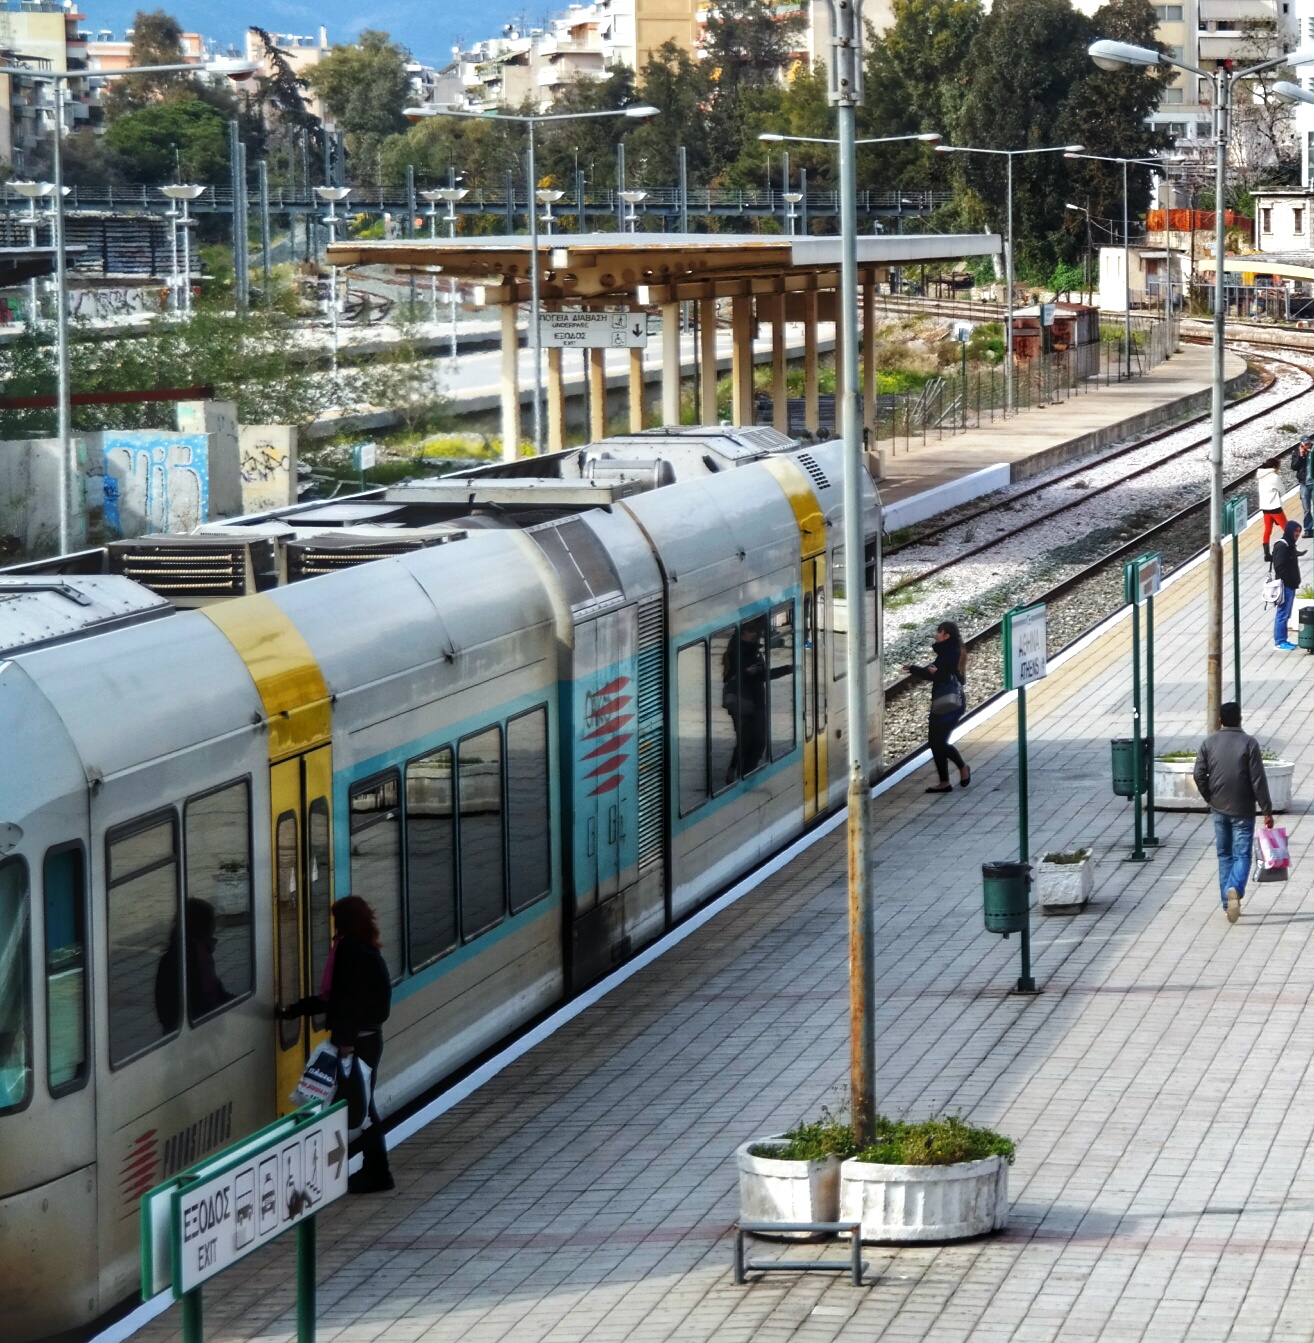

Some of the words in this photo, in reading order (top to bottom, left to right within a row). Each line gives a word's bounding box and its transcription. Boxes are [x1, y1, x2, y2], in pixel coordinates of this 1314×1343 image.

[540, 314, 569, 322] ΠΟΓΕΙΑ
[572, 314, 608, 322] ΔΙΑΒΑΣΗ
[554, 332, 587, 340] ΕΞΟΔΟΣ
[184, 1185, 231, 1244] ΕΞΟΔΟΣ
[198, 1237, 218, 1272] EXIT
